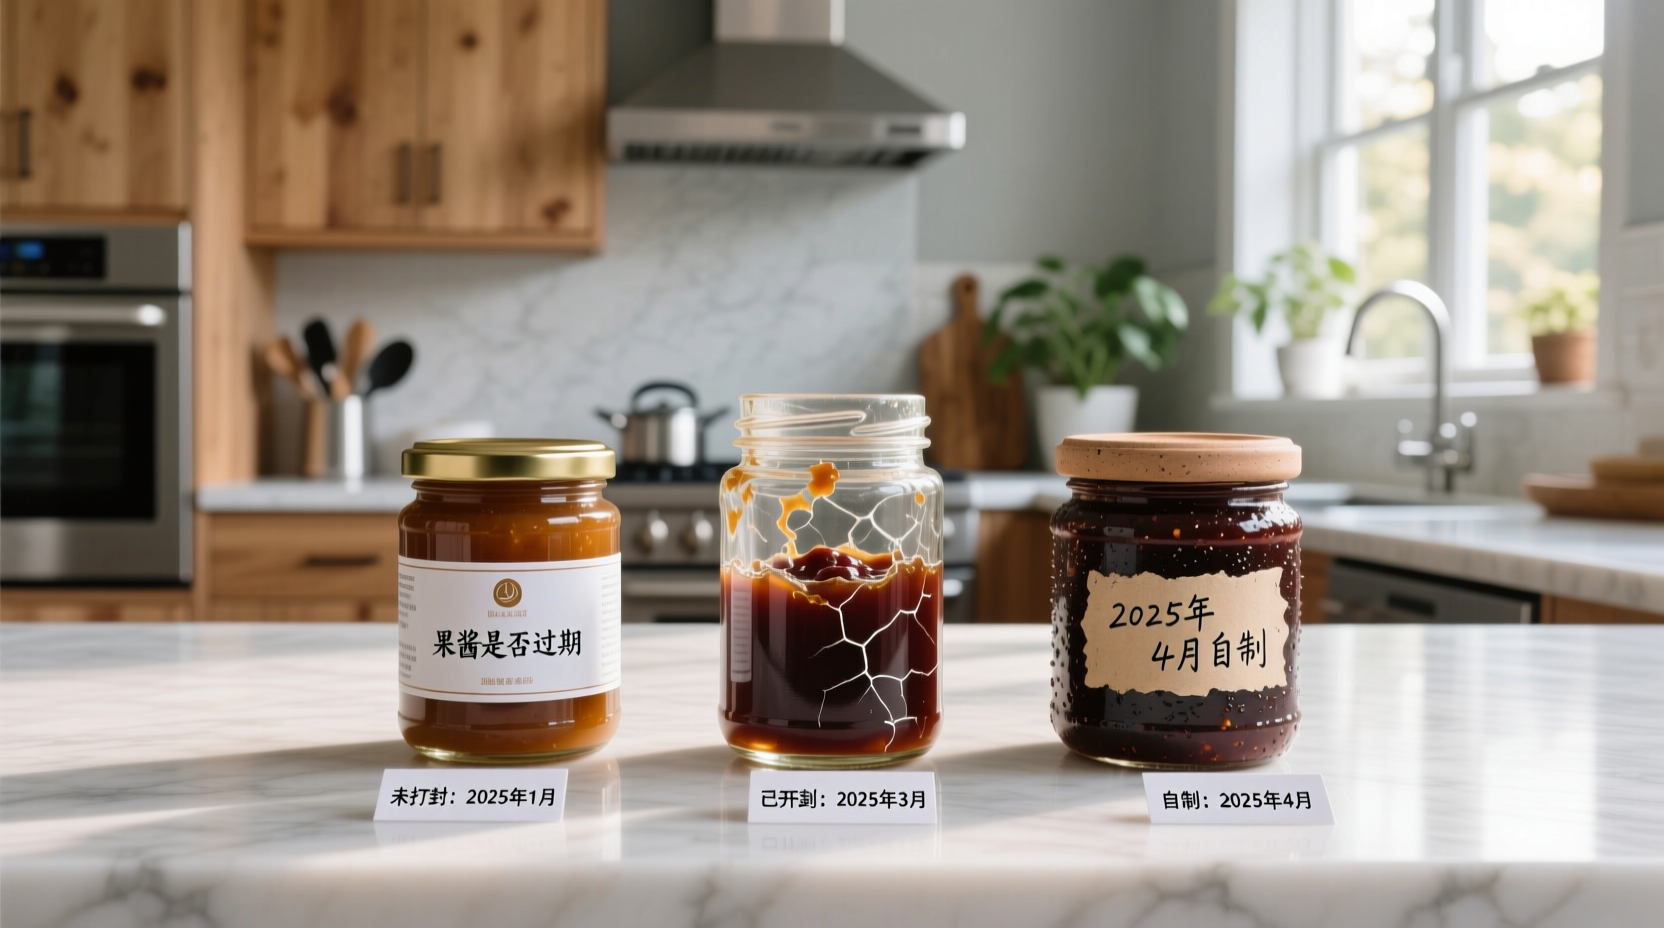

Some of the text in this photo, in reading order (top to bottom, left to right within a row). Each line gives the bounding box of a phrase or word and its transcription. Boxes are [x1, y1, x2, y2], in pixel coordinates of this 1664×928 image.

[1108, 593, 1215, 632] 2025年
[432, 628, 582, 660] 果酱是否过期
[1151, 627, 1266, 673] 4月自制
